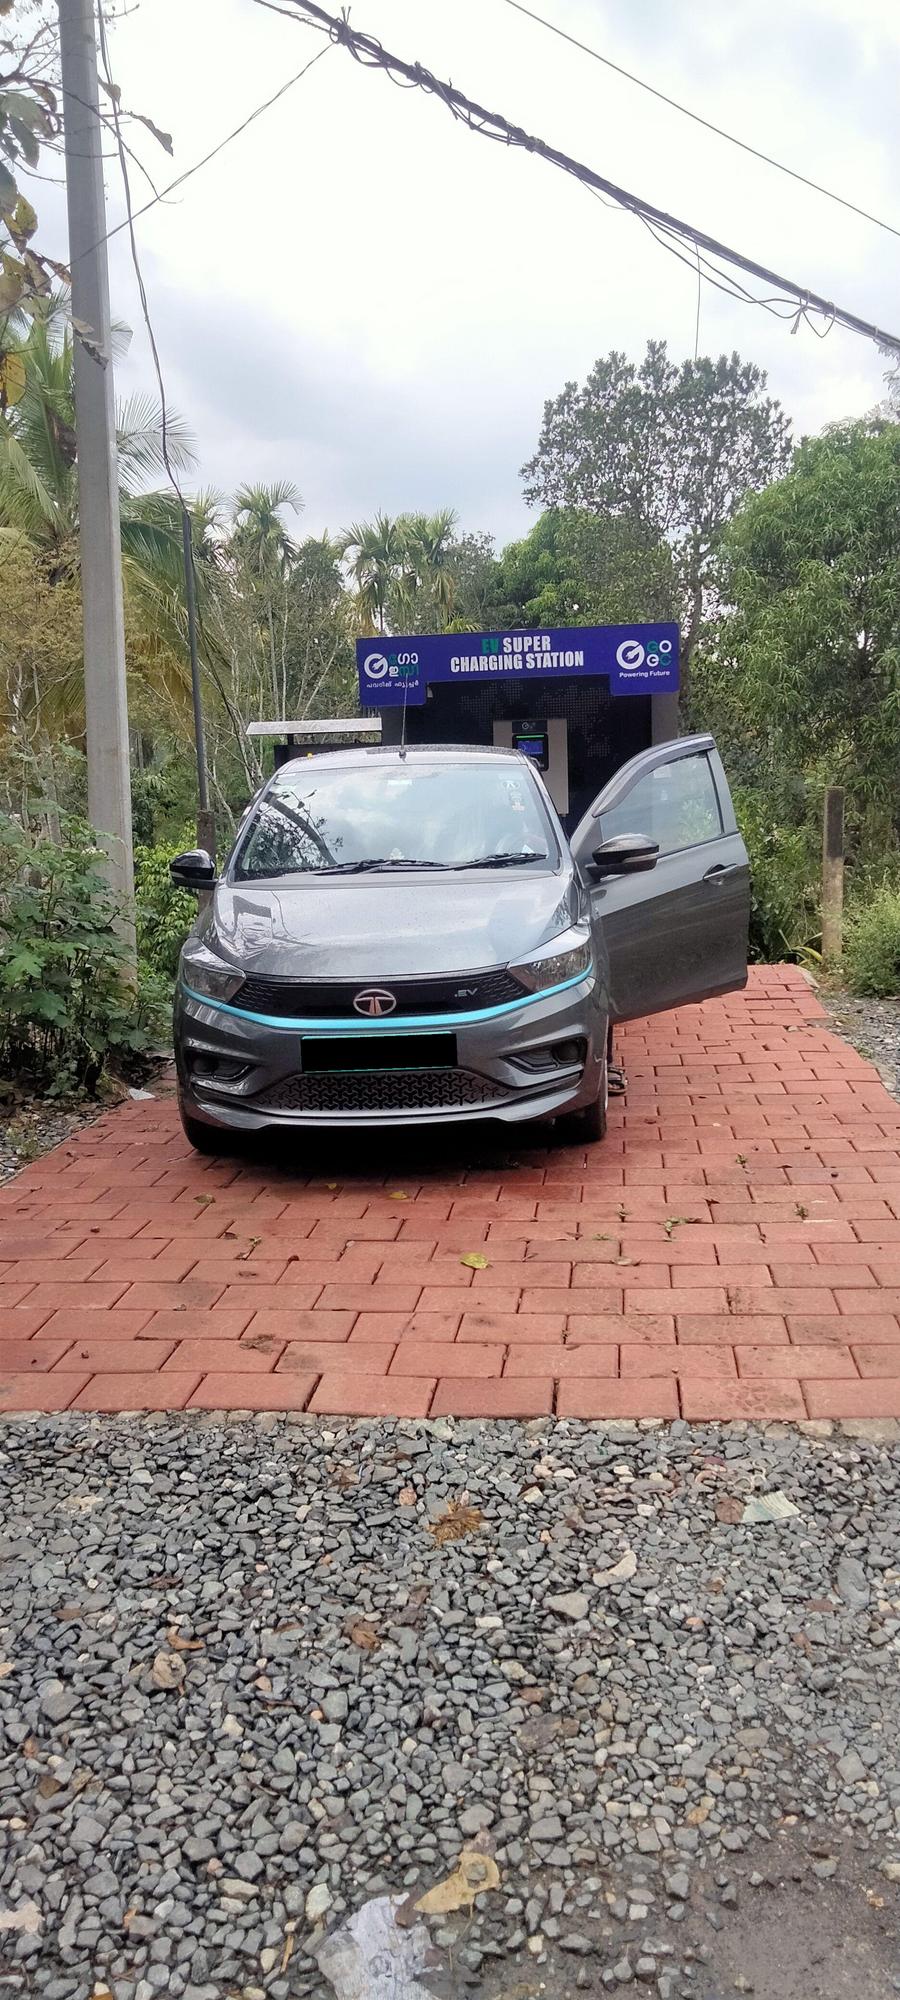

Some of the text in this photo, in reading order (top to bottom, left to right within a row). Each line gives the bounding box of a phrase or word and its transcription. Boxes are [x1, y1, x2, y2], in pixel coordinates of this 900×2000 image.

[481, 635, 551, 654] EV SUPER
[450, 651, 584, 673] CHARGING STATION
